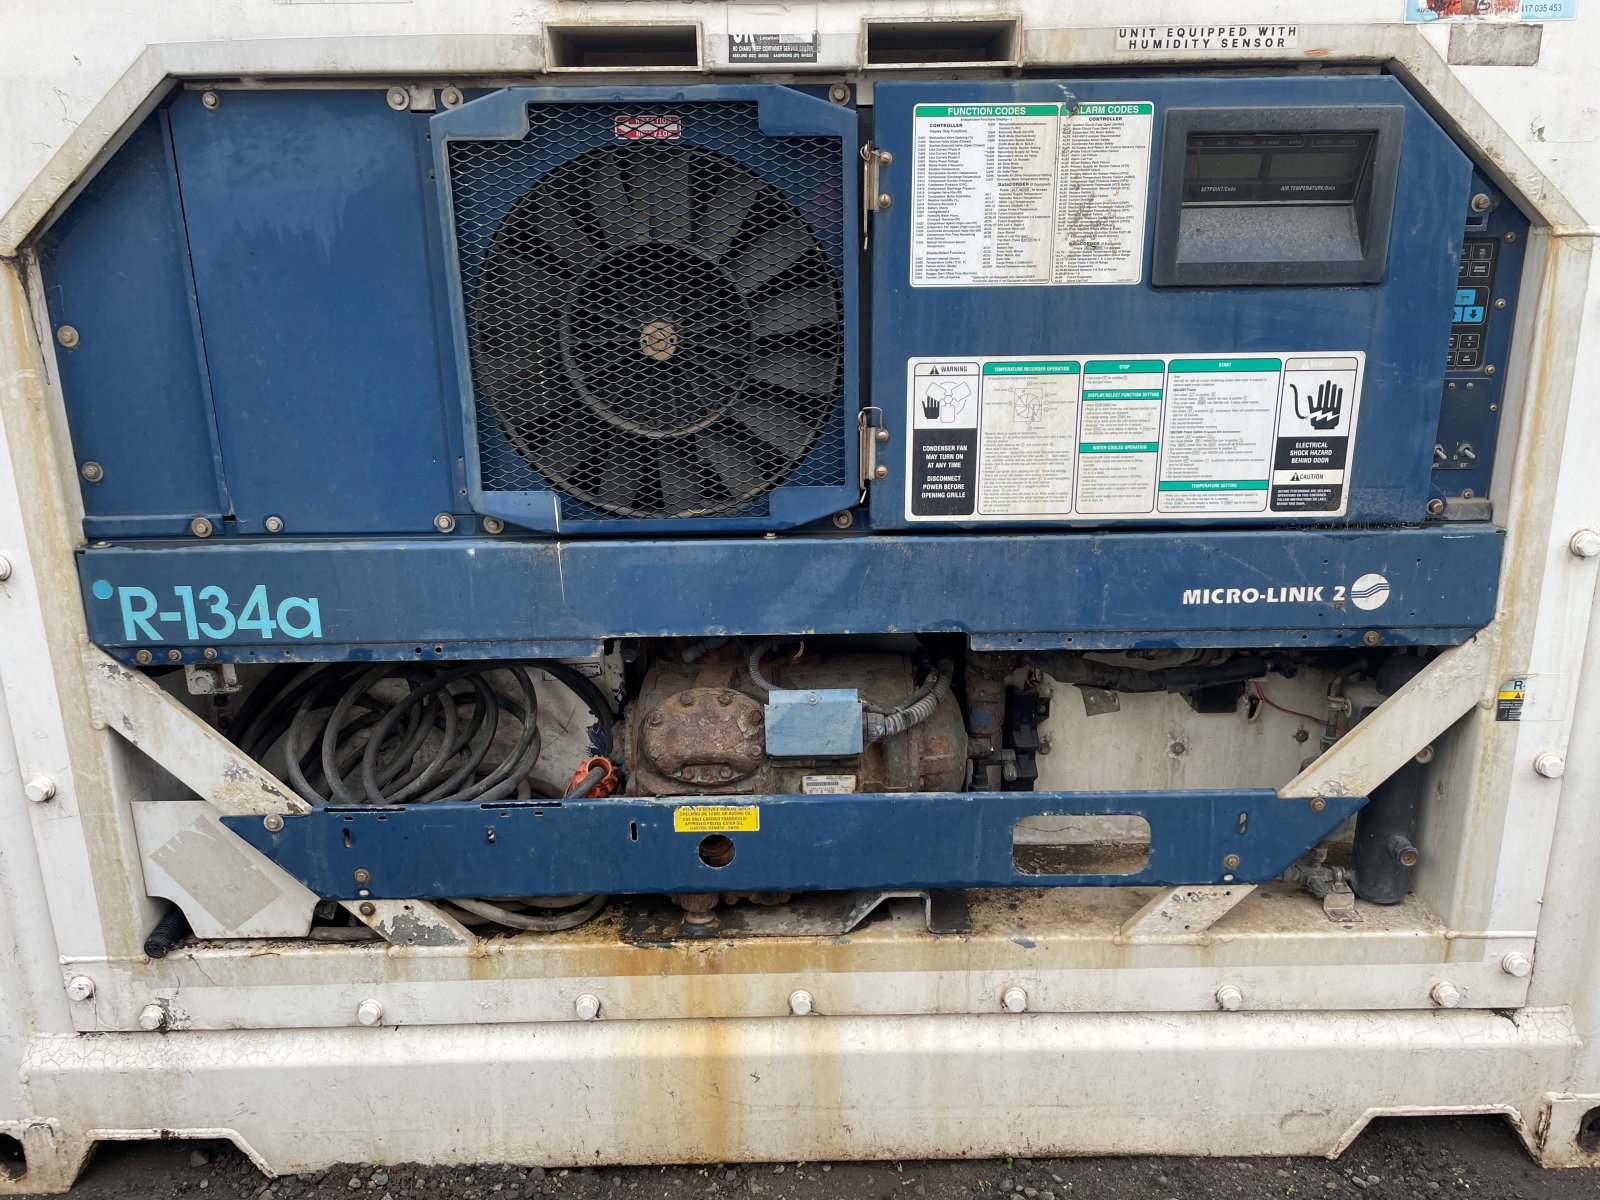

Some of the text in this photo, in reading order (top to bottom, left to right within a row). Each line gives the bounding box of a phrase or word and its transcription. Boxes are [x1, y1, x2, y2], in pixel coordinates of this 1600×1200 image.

[1535, 4, 1548, 13] 035
[1549, 3, 1562, 12] 453
[1119, 26, 1297, 38] UNIT EQUIPPED WITH
[1129, 37, 1286, 48] HUMIDITY SENSOR
[948, 106, 1026, 116] FUNCTION CODES
[1108, 105, 1140, 114] CODES
[1182, 586, 1346, 605] MICRO-LINK 2
[118, 584, 322, 642] R-134a
